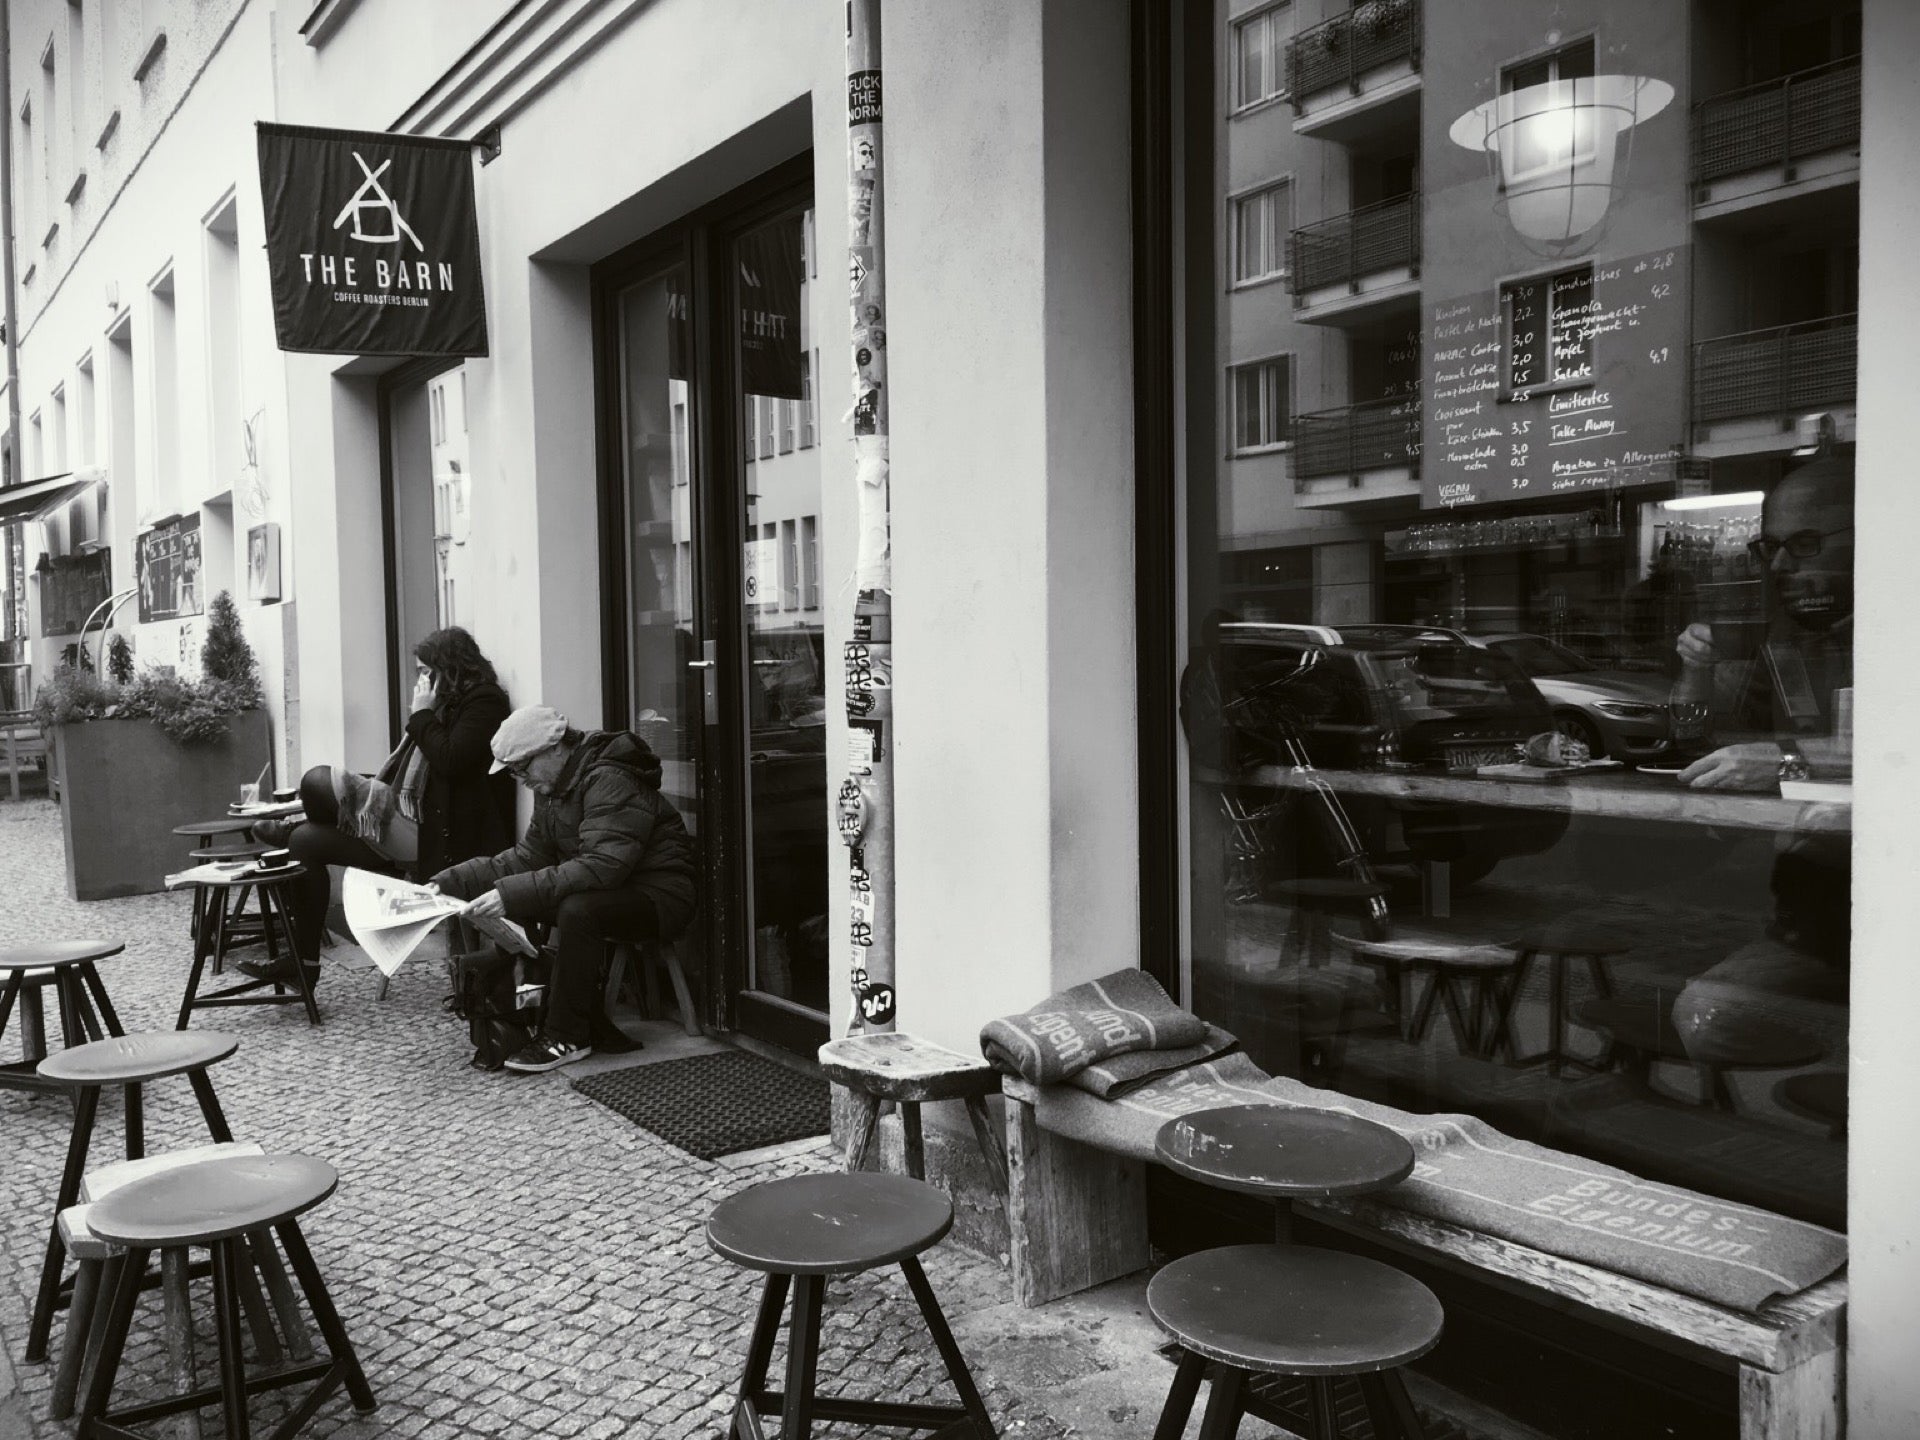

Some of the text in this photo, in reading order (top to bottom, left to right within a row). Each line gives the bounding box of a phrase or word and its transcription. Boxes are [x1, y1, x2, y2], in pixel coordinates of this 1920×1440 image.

[849, 76, 880, 93] FUCK
[851, 90, 877, 105] THE
[848, 105, 881, 121] NORM
[300, 254, 453, 291] THE BARN
[1552, 252, 1674, 295] Sandwiches ab 2,8
[334, 291, 429, 307] COFFEE ROASTERS BERLIN
[1518, 287, 1533, 300] 3,0
[1651, 284, 1670, 299] 4,2
[1515, 306, 1534, 322] 2,2
[1552, 300, 1602, 320] Granola
[1512, 332, 1534, 348] 3,0
[1512, 354, 1532, 366] 2,0
[1514, 369, 1531, 384] 1,5
[1552, 363, 1592, 381] Salate
[1511, 390, 1531, 402] 2,5
[1511, 420, 1532, 435] 3,5
[1511, 443, 1529, 455] 3,0
[1510, 455, 1530, 467] 0,5
[1512, 478, 1529, 490] 3,0
[1566, 1179, 1769, 1233] Bundes-
